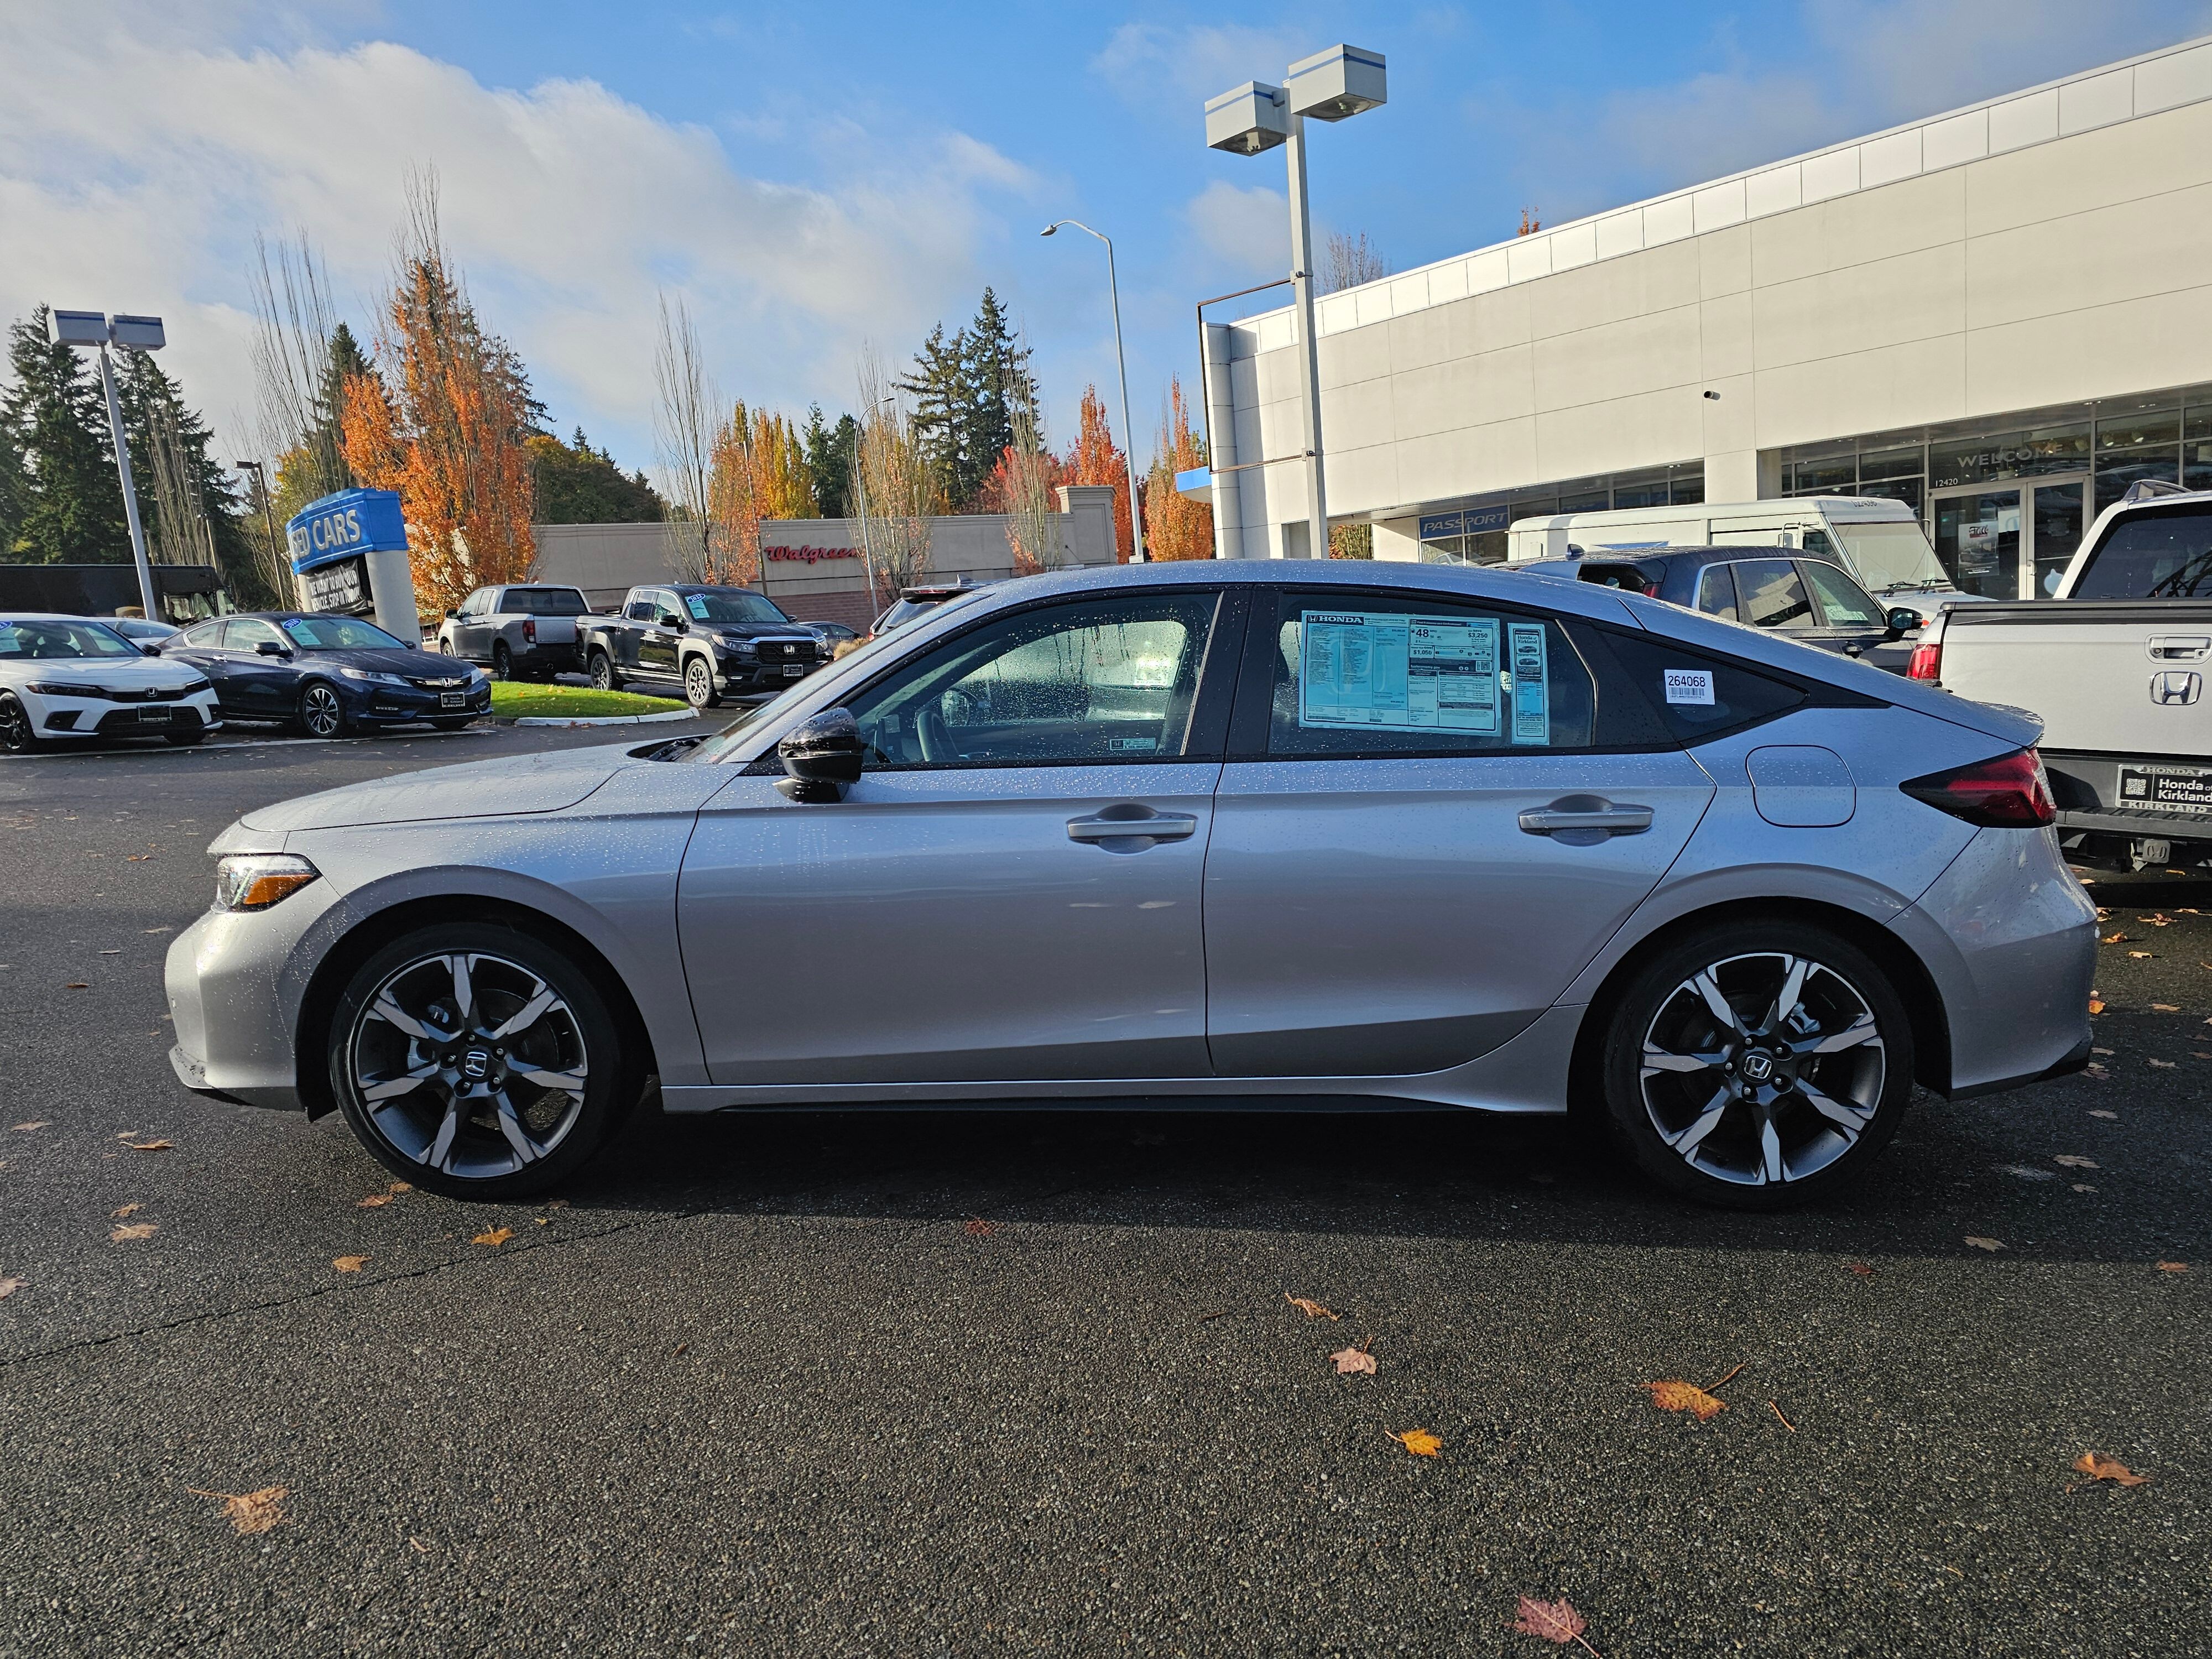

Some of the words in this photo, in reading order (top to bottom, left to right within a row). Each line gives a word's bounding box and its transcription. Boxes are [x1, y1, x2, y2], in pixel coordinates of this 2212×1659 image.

[1957, 444, 2063, 468] WELCOME
[1936, 477, 1958, 487] 12420
[1423, 512, 1509, 533] PASSPORT
[312, 509, 361, 551] CARS
[764, 544, 865, 565] Walgreen
[309, 582, 317, 596] WE
[316, 578, 330, 594] WANT
[328, 576, 335, 591] TO
[328, 592, 340, 608] STOP
[338, 591, 346, 606] IN
[285, 619, 299, 628] 2016
[1319, 615, 1363, 624] HONDA
[1416, 629, 1429, 638] 48
[1668, 675, 1705, 687] 264068
[2146, 766, 2196, 775] HONDA
[2159, 779, 2204, 791] Honda
[2158, 789, 2212, 802] Kirkland
[2128, 801, 2207, 813] KIRKLAND
